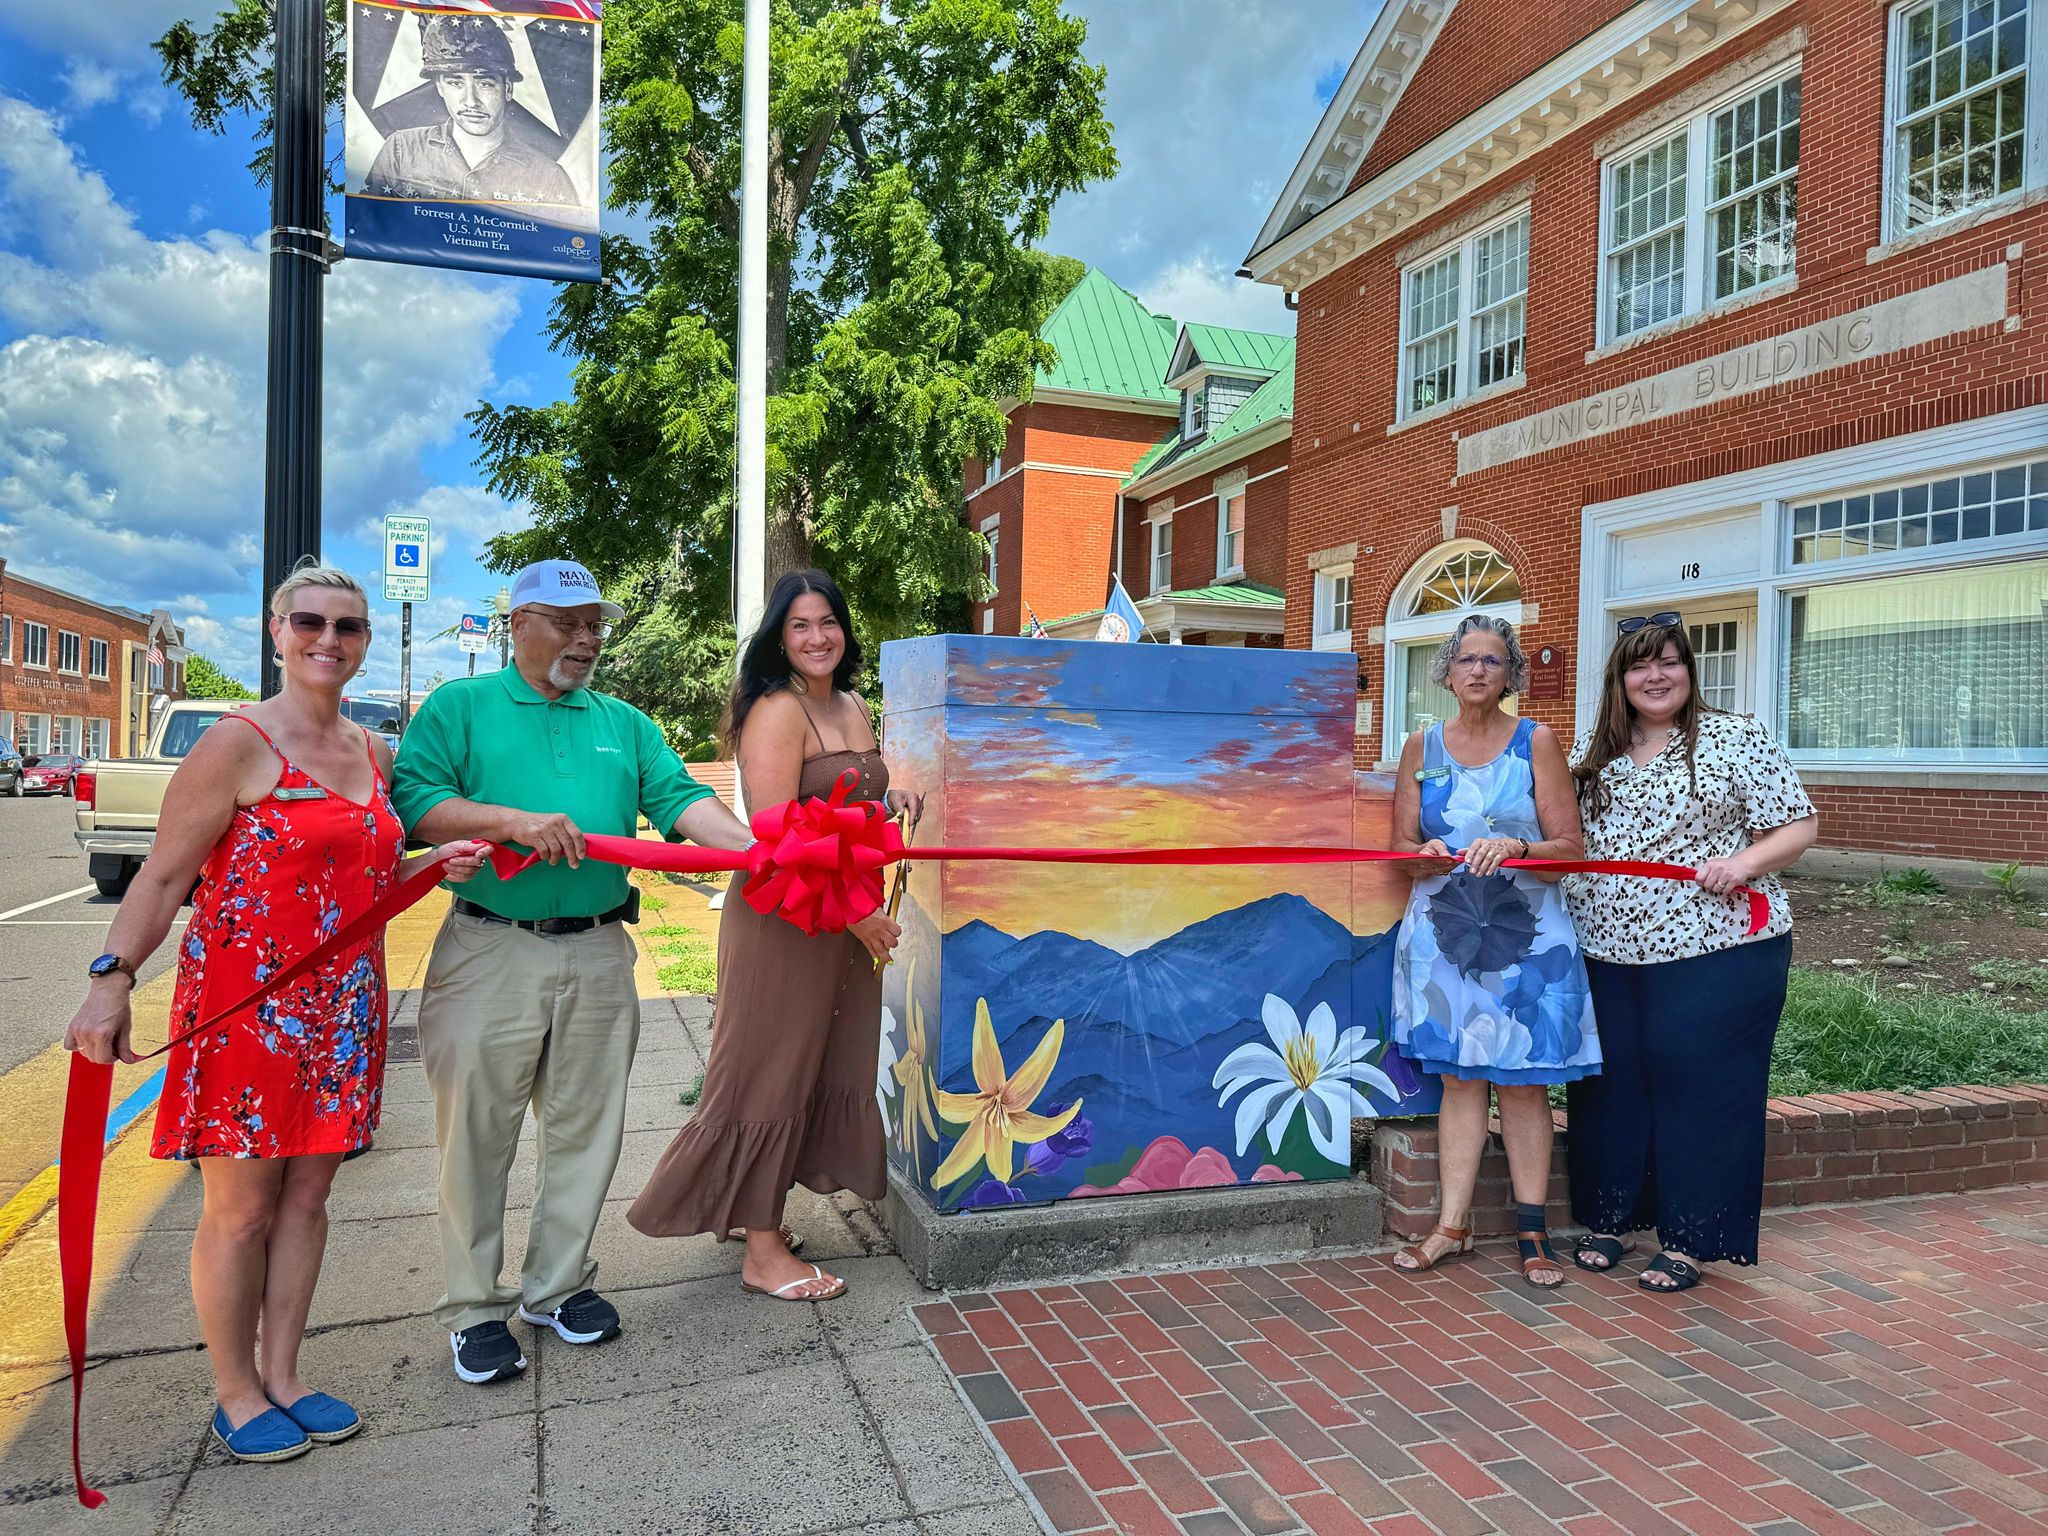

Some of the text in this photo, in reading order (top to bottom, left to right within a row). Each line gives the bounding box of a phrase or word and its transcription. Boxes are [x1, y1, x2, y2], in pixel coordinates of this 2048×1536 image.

[413, 205, 539, 233] Forrest A. McCormick
[448, 222, 505, 242] U.S. Army
[442, 233, 510, 251] Vietnam Era
[552, 244, 591, 257] culpeper
[1518, 315, 1874, 452] MUNICIPAL BUILDING
[388, 522, 428, 532] RESERVED
[390, 533, 424, 542] PARKING
[1681, 562, 1700, 581] 118
[15, 676, 40, 686] CULPEPER
